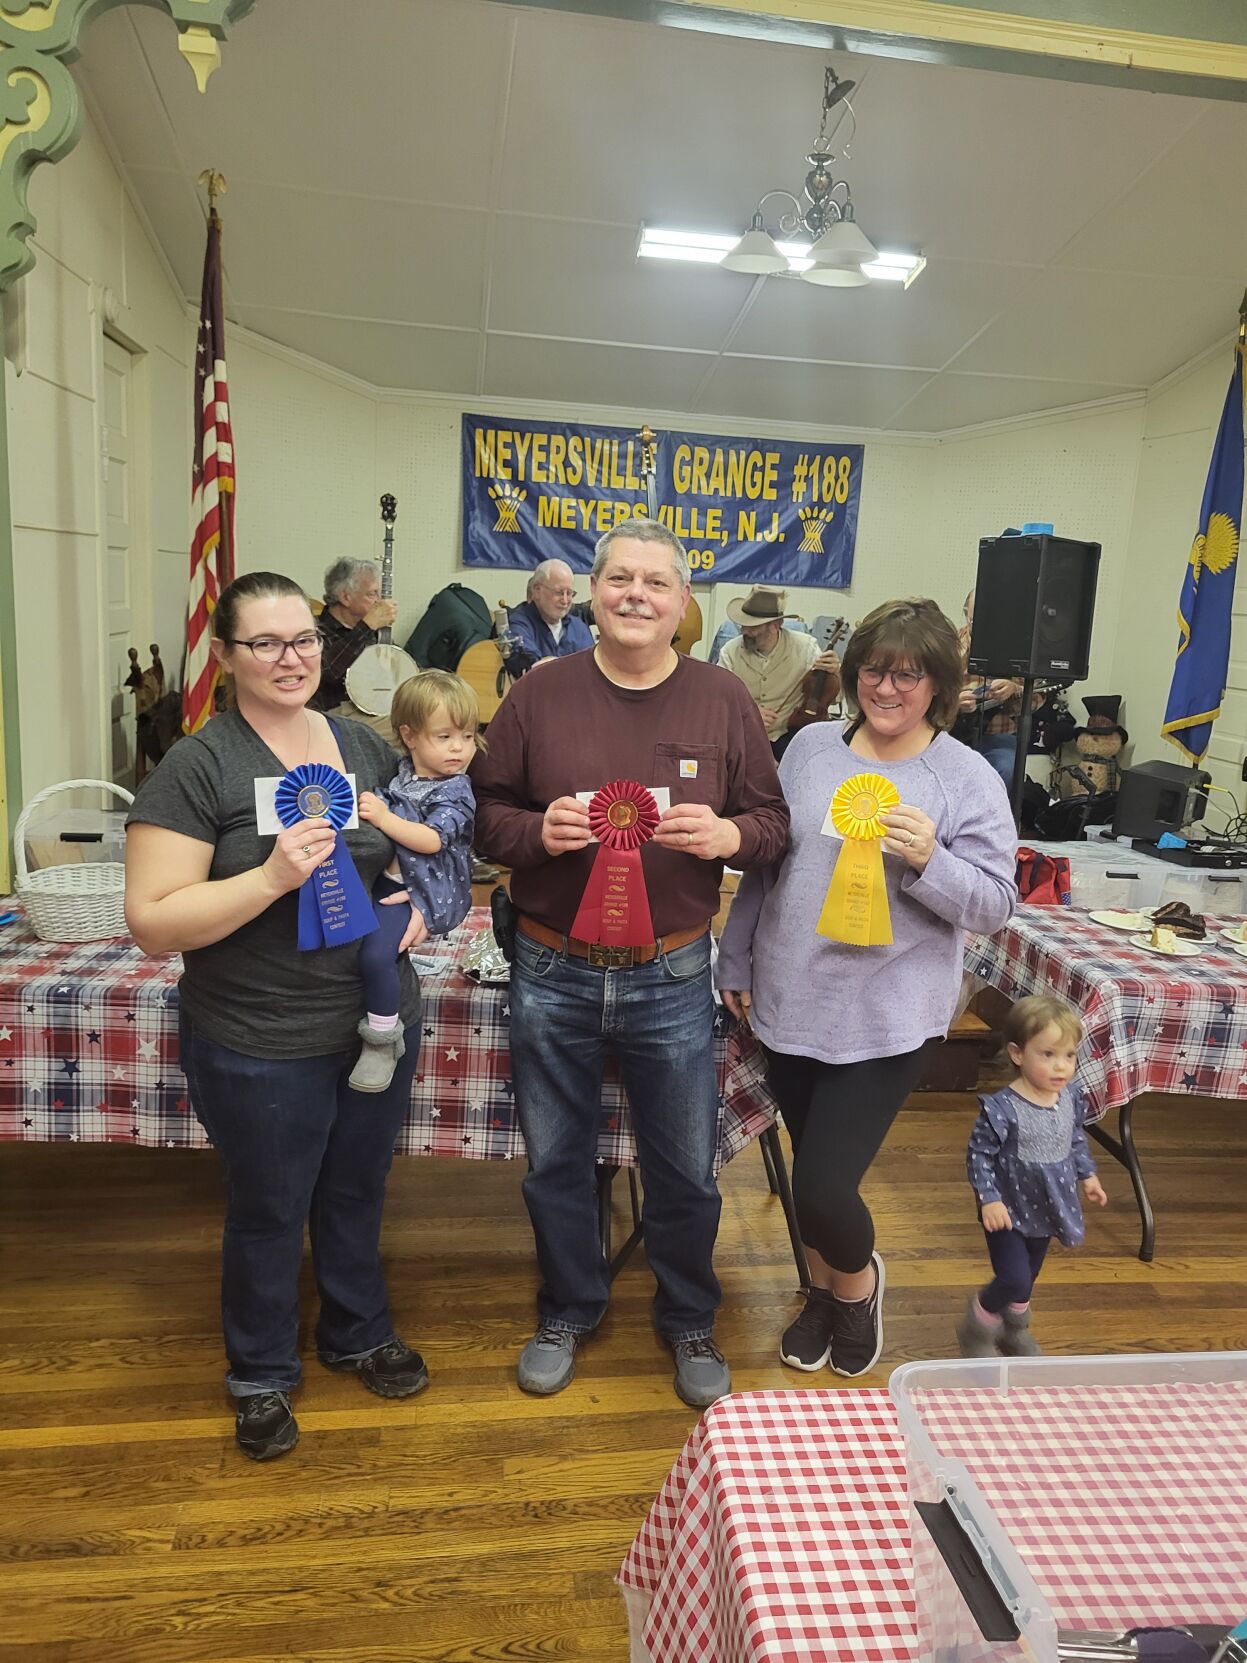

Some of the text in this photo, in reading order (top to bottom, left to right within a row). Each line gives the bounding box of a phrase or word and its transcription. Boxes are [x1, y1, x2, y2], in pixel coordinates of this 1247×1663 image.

[673, 444, 780, 500] GRANGE
[792, 454, 851, 504] #188
[737, 510, 785, 543] N.J.
[687, 549, 715, 570] 09
[319, 868, 338, 878] PLACE
